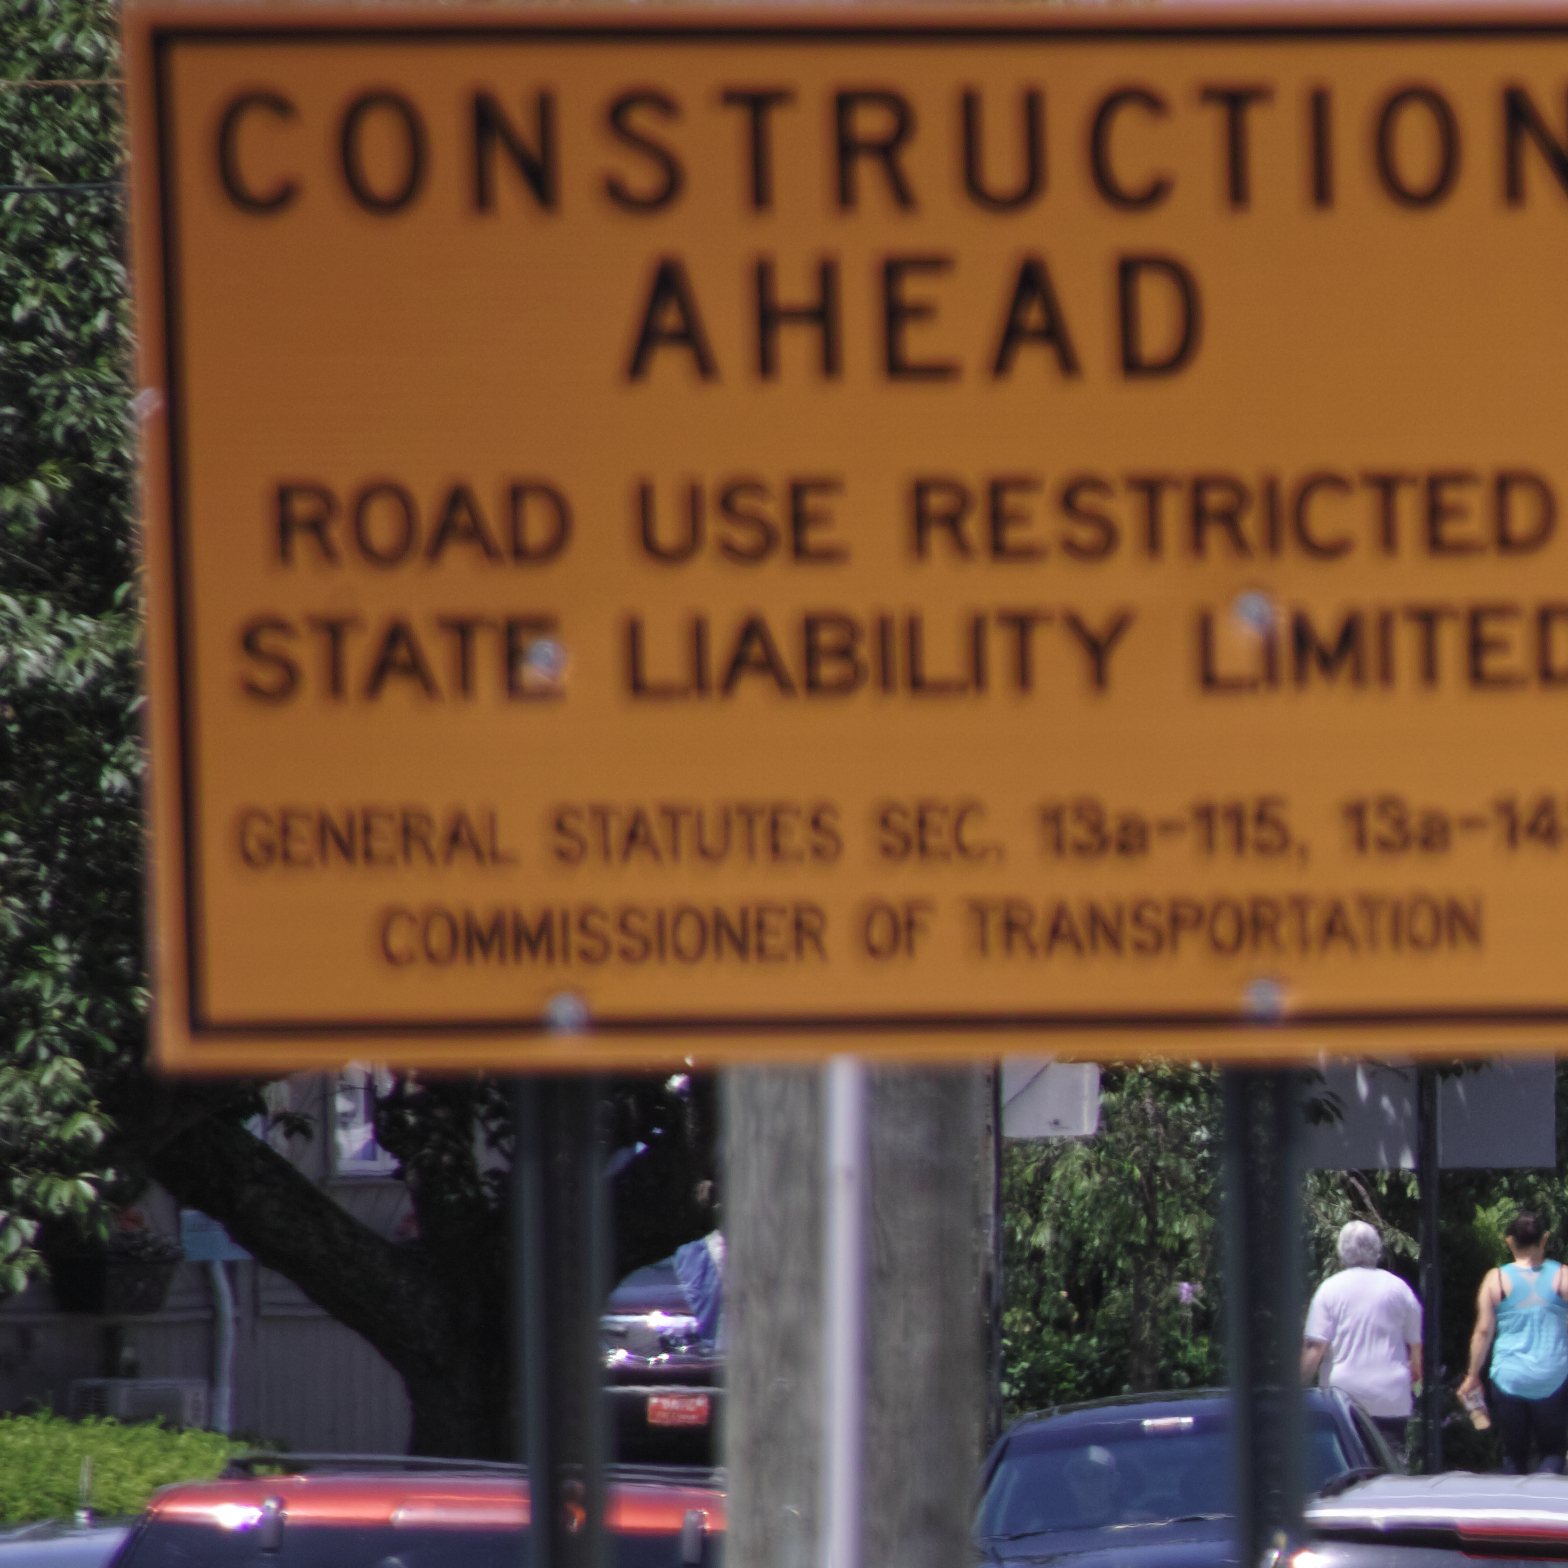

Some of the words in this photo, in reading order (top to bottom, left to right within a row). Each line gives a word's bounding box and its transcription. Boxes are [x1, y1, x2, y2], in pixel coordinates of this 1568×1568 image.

[625, 250, 1206, 383] AHEAD
[270, 478, 575, 568] ROAD
[636, 474, 850, 566] USE
[908, 466, 1560, 562] RESTRICTED
[238, 612, 568, 706] STATE
[624, 608, 1136, 703] LIABILITY
[237, 804, 519, 871] GENERAL
[550, 801, 844, 867] STATUTES
[876, 799, 1005, 865] SEC.
[379, 902, 829, 967] COMMISSIONER
[862, 898, 938, 962] OF
[964, 892, 1485, 959] TRANSPORTATION
